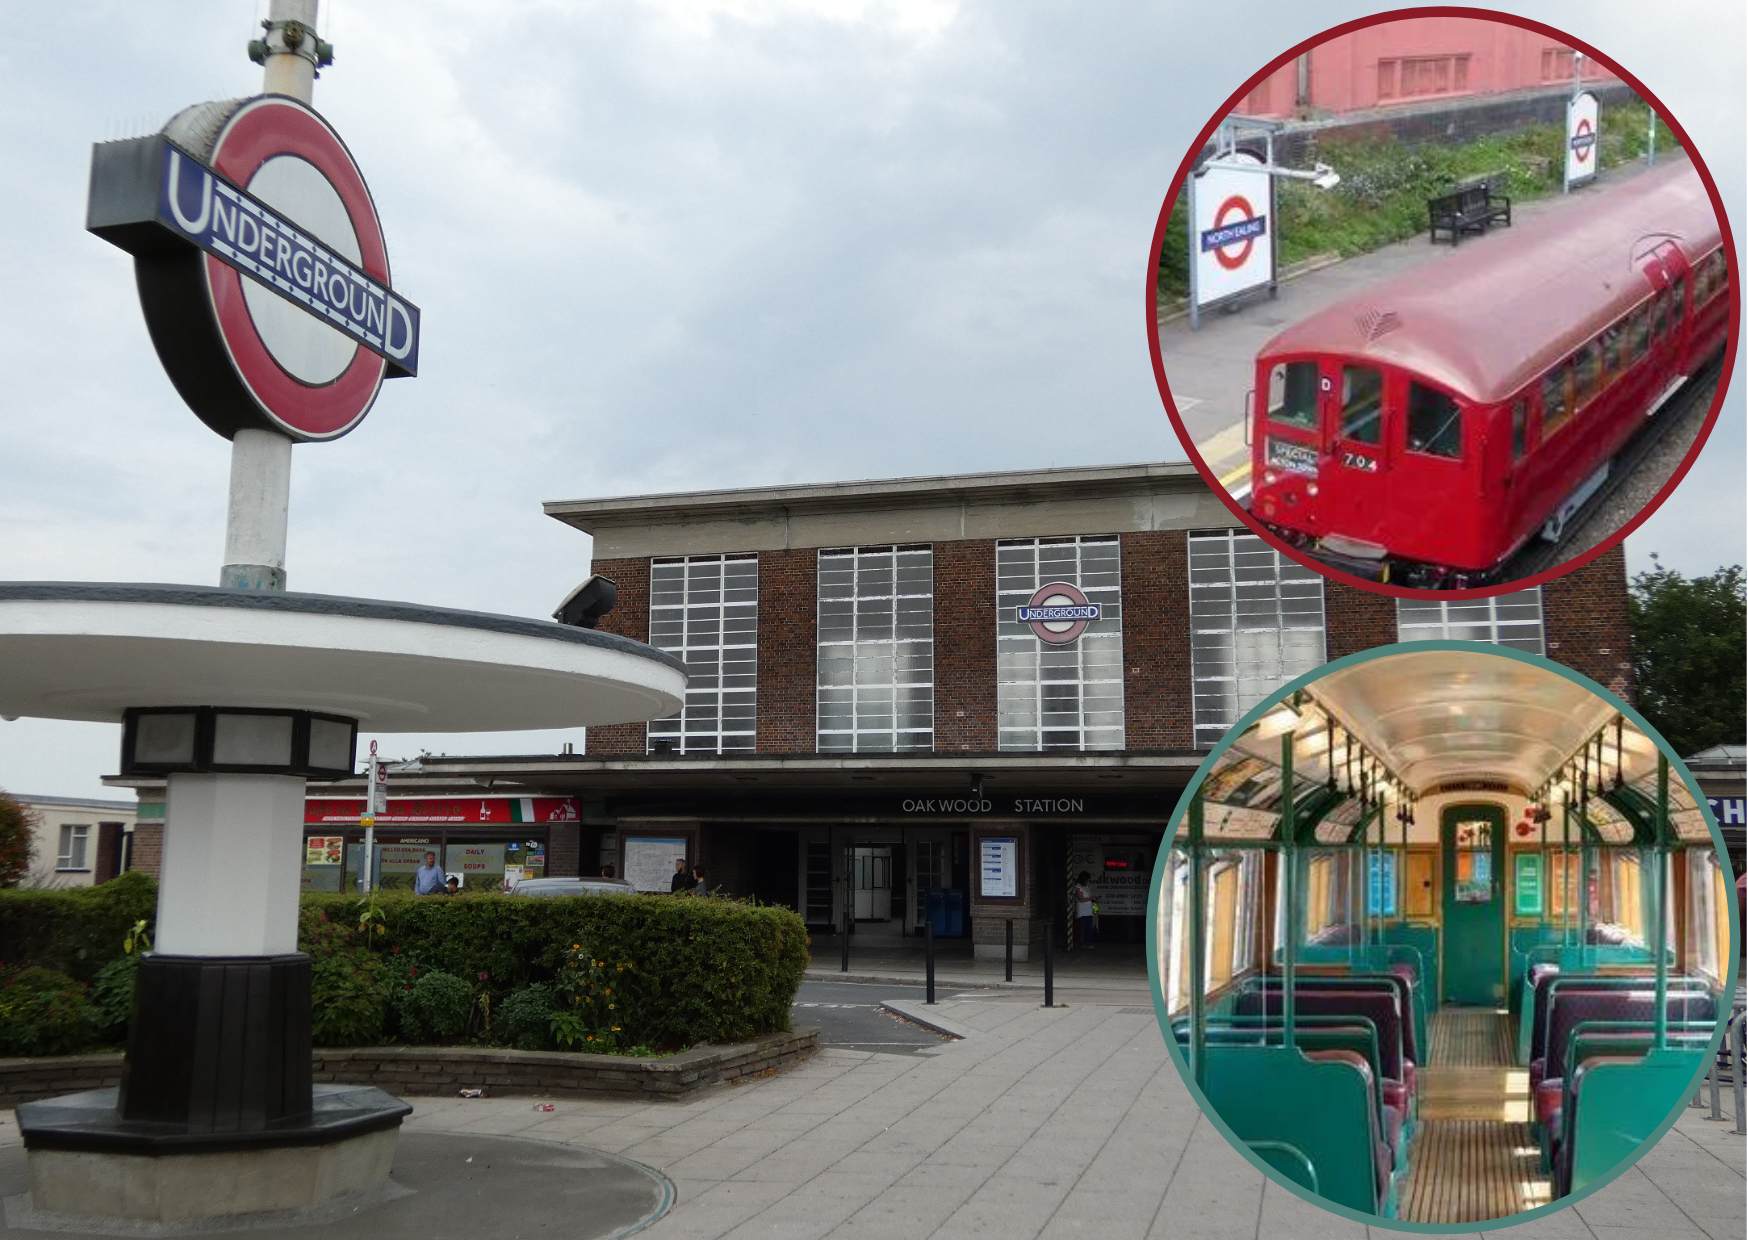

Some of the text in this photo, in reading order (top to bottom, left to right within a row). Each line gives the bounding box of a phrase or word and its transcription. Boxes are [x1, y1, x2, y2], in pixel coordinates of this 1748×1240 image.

[1206, 219, 1260, 246] NORTH EALING
[168, 150, 413, 360] UNDERGROUND
[1321, 378, 1331, 391] D
[1345, 453, 1377, 473] 704
[1019, 606, 1098, 620] UNDERGROUND
[1015, 799, 1083, 812] STATION
